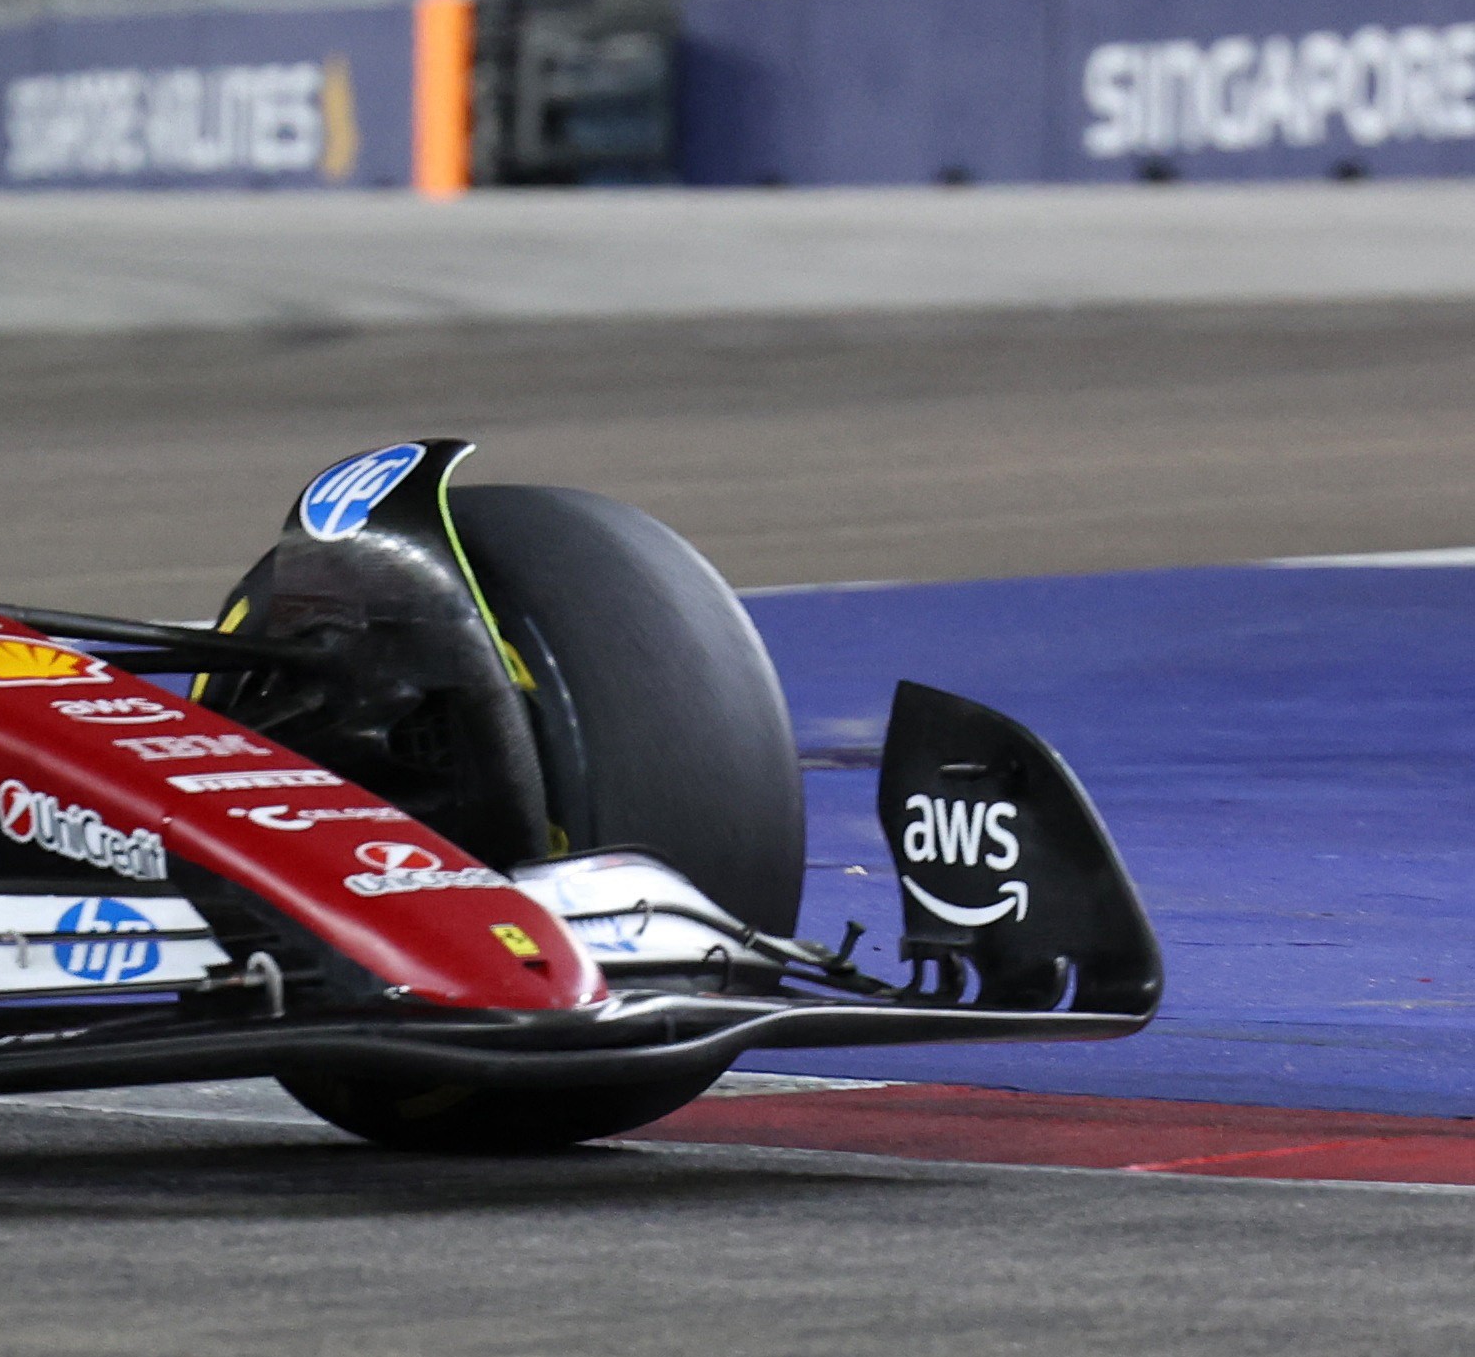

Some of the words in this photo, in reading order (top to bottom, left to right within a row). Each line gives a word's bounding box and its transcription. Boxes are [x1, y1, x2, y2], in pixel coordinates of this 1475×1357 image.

[30, 792, 169, 882] UniCredit
[903, 793, 1020, 872] aws
[66, 898, 154, 983] hp
